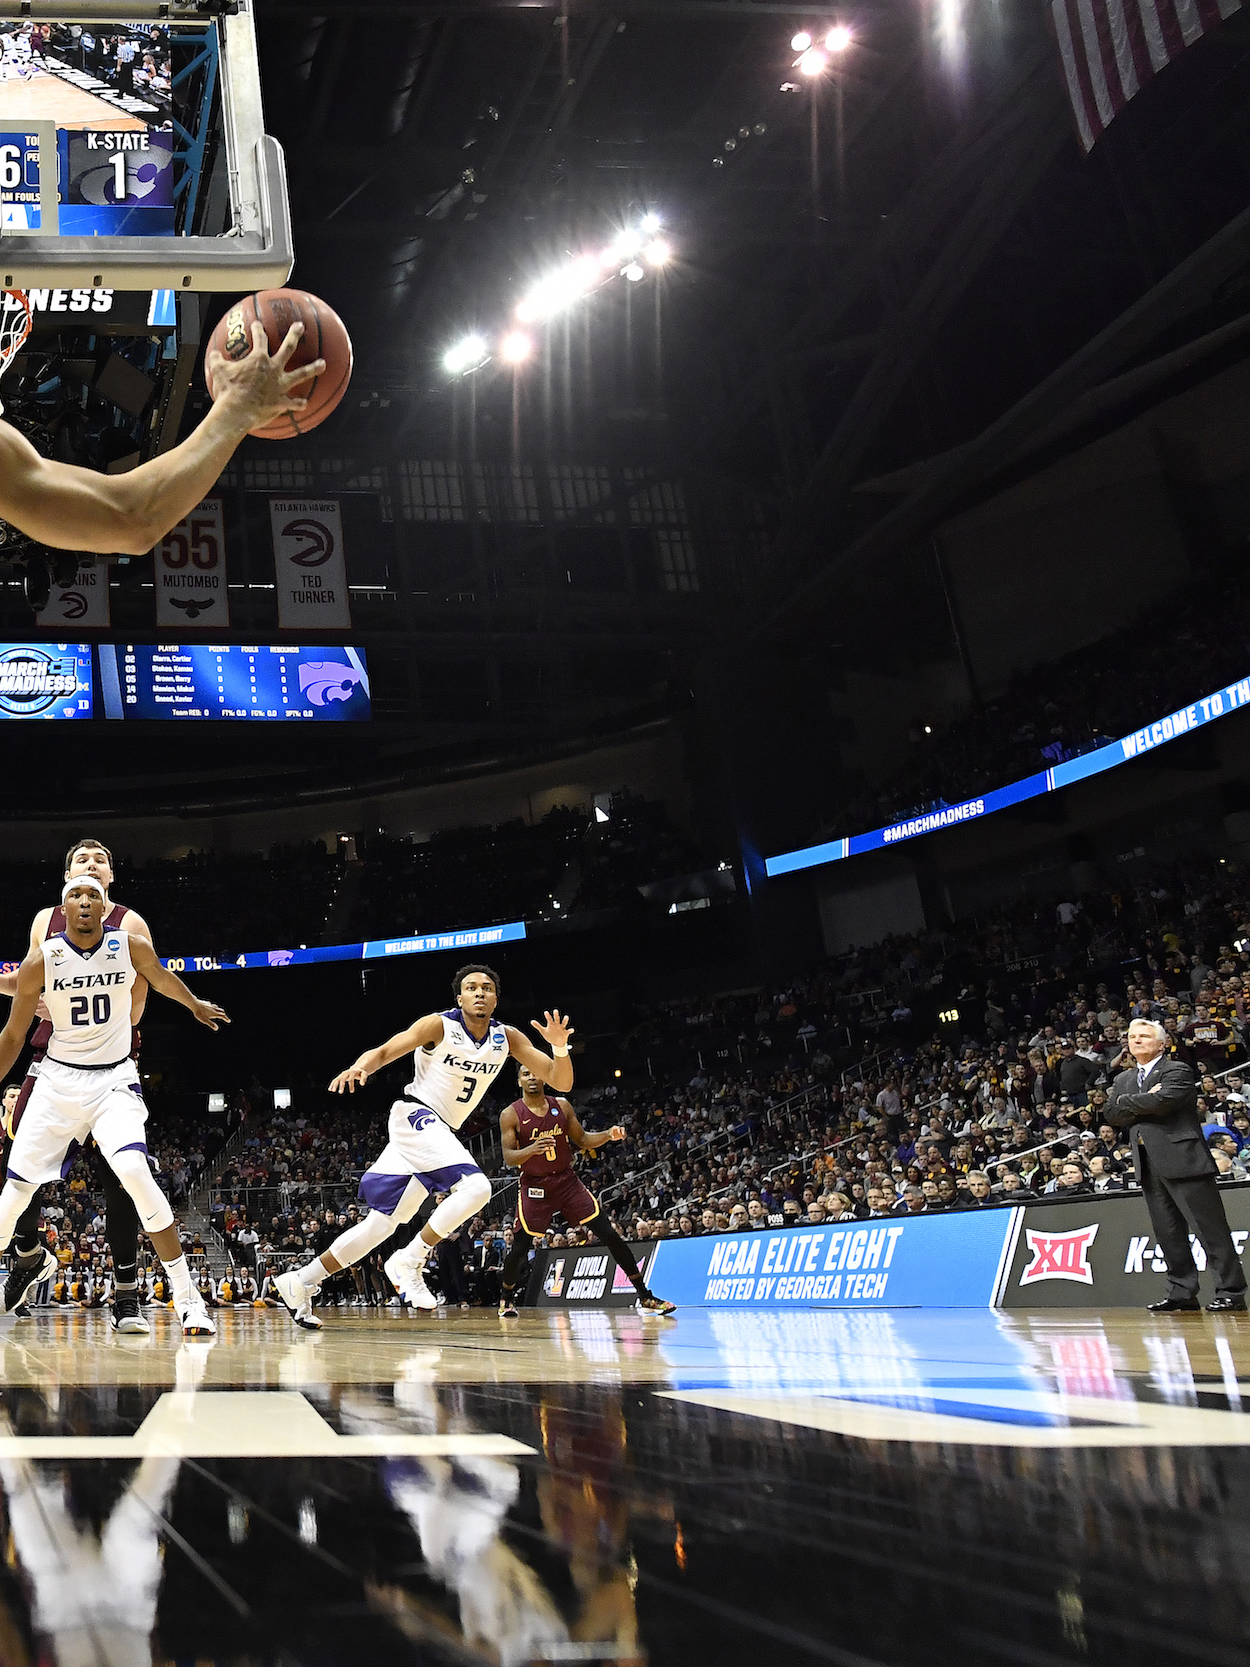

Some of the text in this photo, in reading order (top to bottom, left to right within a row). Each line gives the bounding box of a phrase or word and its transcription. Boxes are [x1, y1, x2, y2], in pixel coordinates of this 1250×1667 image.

[88, 133, 149, 150] K-STATE
[108, 152, 126, 199] 1
[194, 502, 218, 511] AWKS
[274, 503, 336, 512] ATLANTA HAWKS
[161, 519, 218, 569] 55
[163, 574, 219, 589] MUTOMBO
[300, 575, 322, 588] TED
[291, 590, 335, 604] TURNER
[1121, 679, 1250, 758] WELCOME TO TH
[883, 799, 984, 842] #MARCHMADNESS
[384, 929, 503, 954] WELCOME TO THE ELITE EIGHT
[167, 958, 185, 972] 00
[236, 954, 246, 968] 4
[52, 971, 126, 991] K-STATE
[70, 993, 111, 1025] 20
[939, 1009, 959, 1023] 113
[456, 1077, 477, 1103] 3
[768, 1213, 784, 1224] POSS
[707, 1226, 904, 1276] NCAA ELITE EIGHT
[574, 1256, 608, 1277] LOYOLA
[566, 1278, 607, 1299] CHICAGO
[704, 1273, 889, 1300] HOSTED BY GEORGIA TECH
